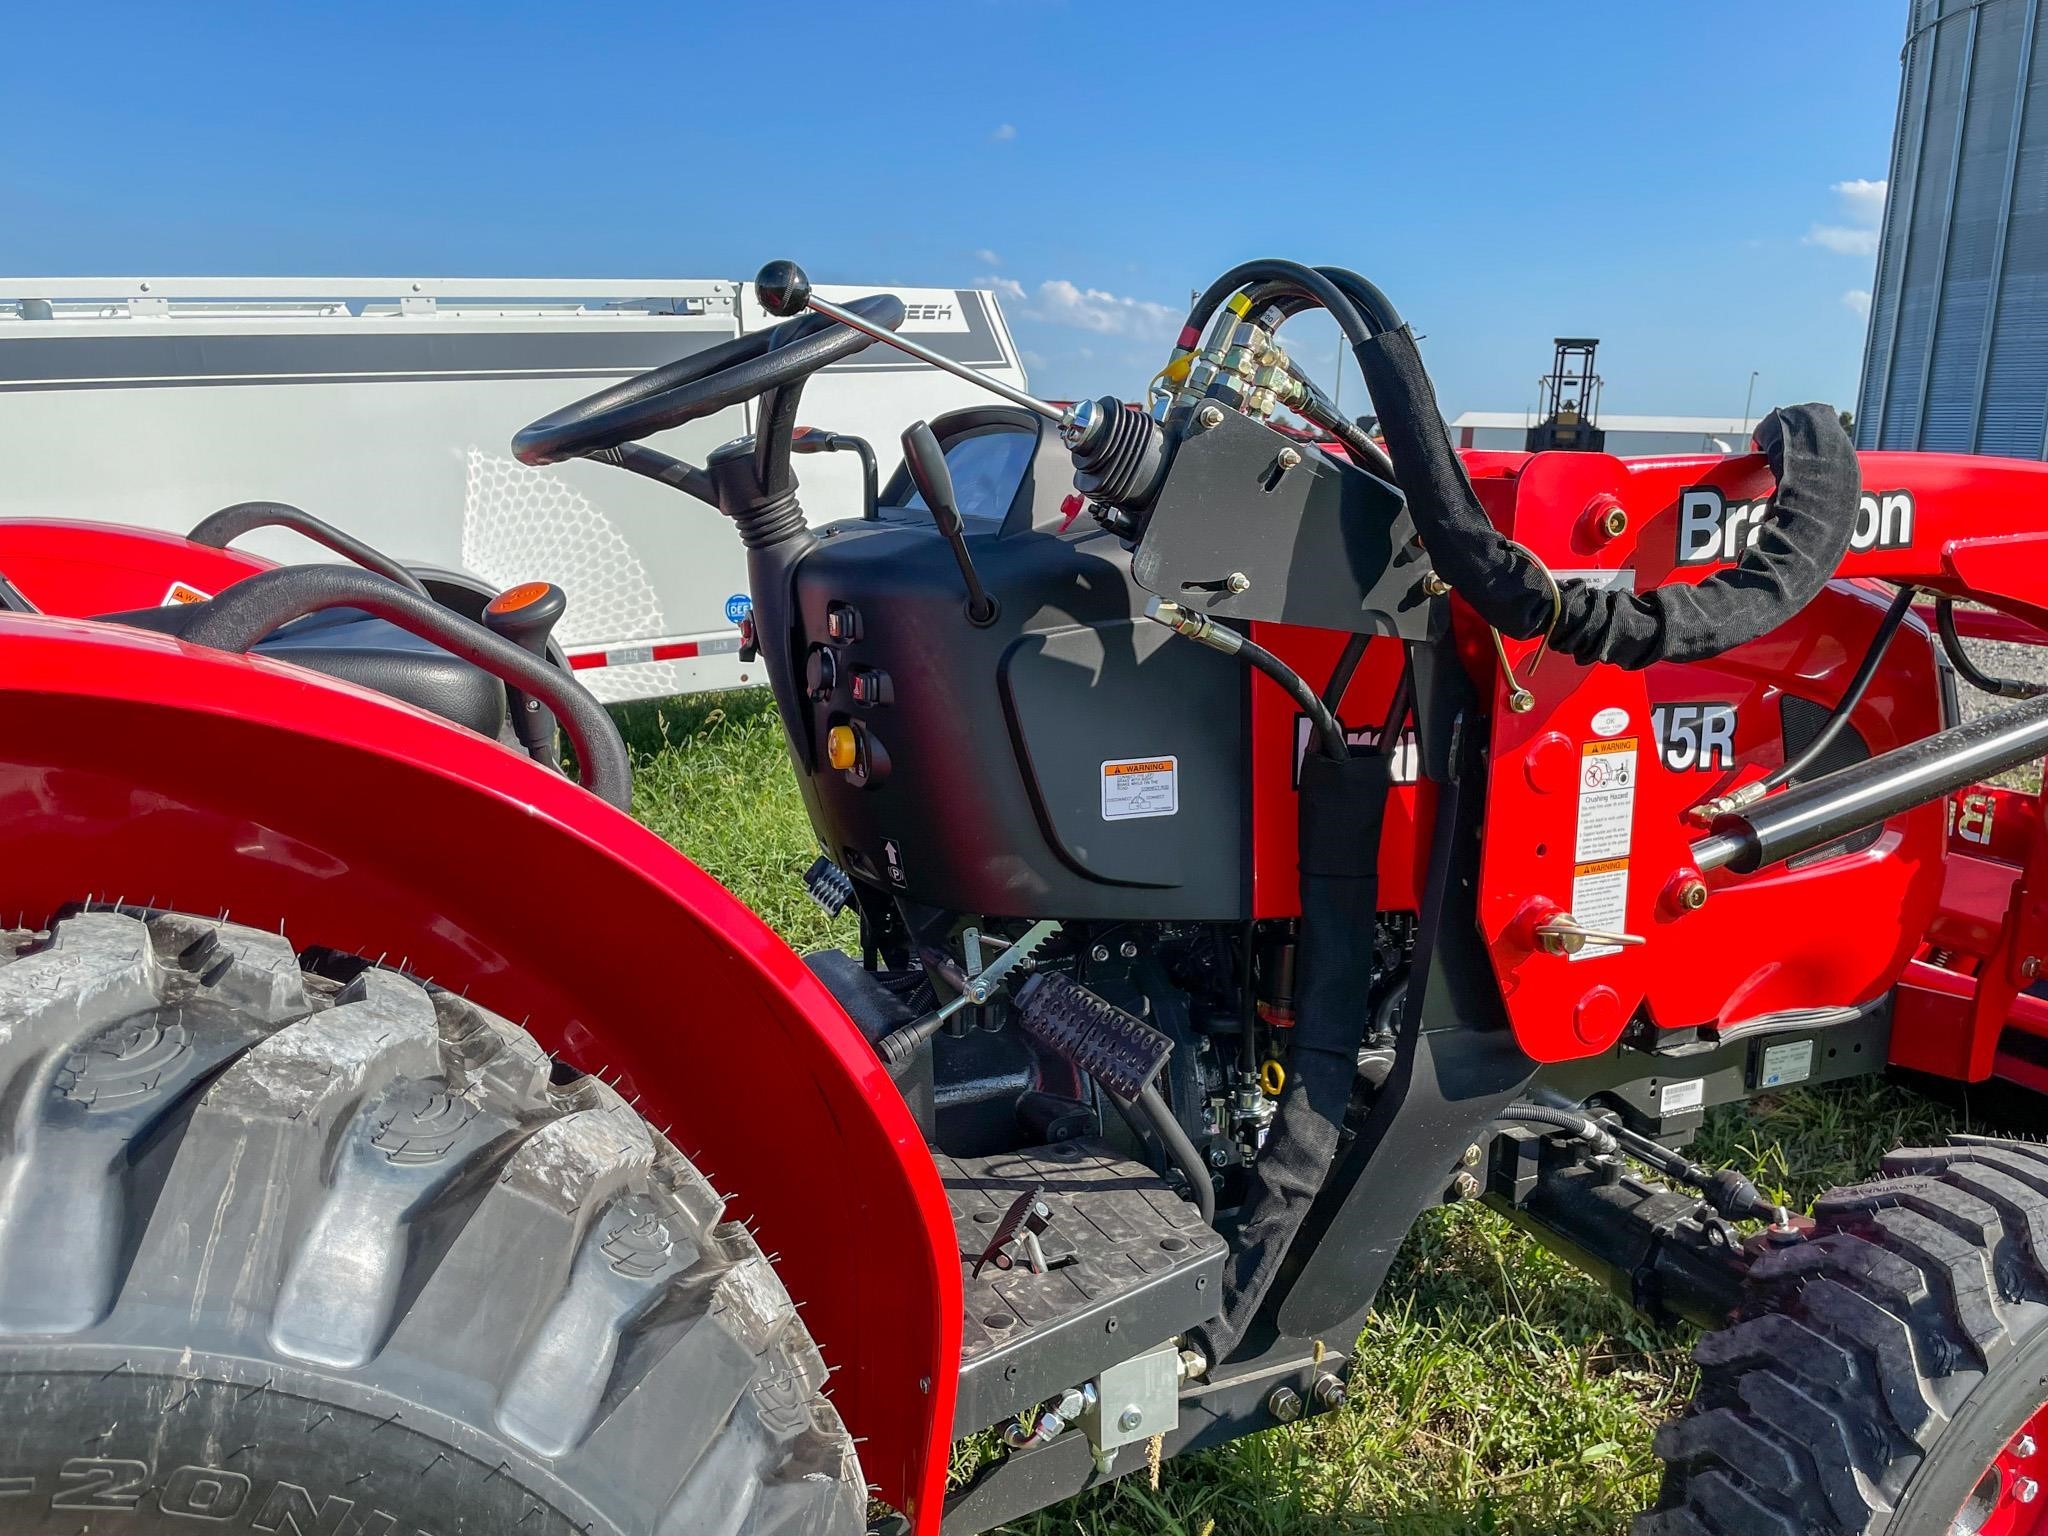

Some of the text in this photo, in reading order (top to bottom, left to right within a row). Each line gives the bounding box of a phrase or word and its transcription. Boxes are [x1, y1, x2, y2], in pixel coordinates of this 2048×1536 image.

[904, 304, 951, 320] EEK
[1600, 741, 1631, 752] WARNING
[1126, 763, 1164, 772] WARNING
[1591, 861, 1620, 872] WARNING
